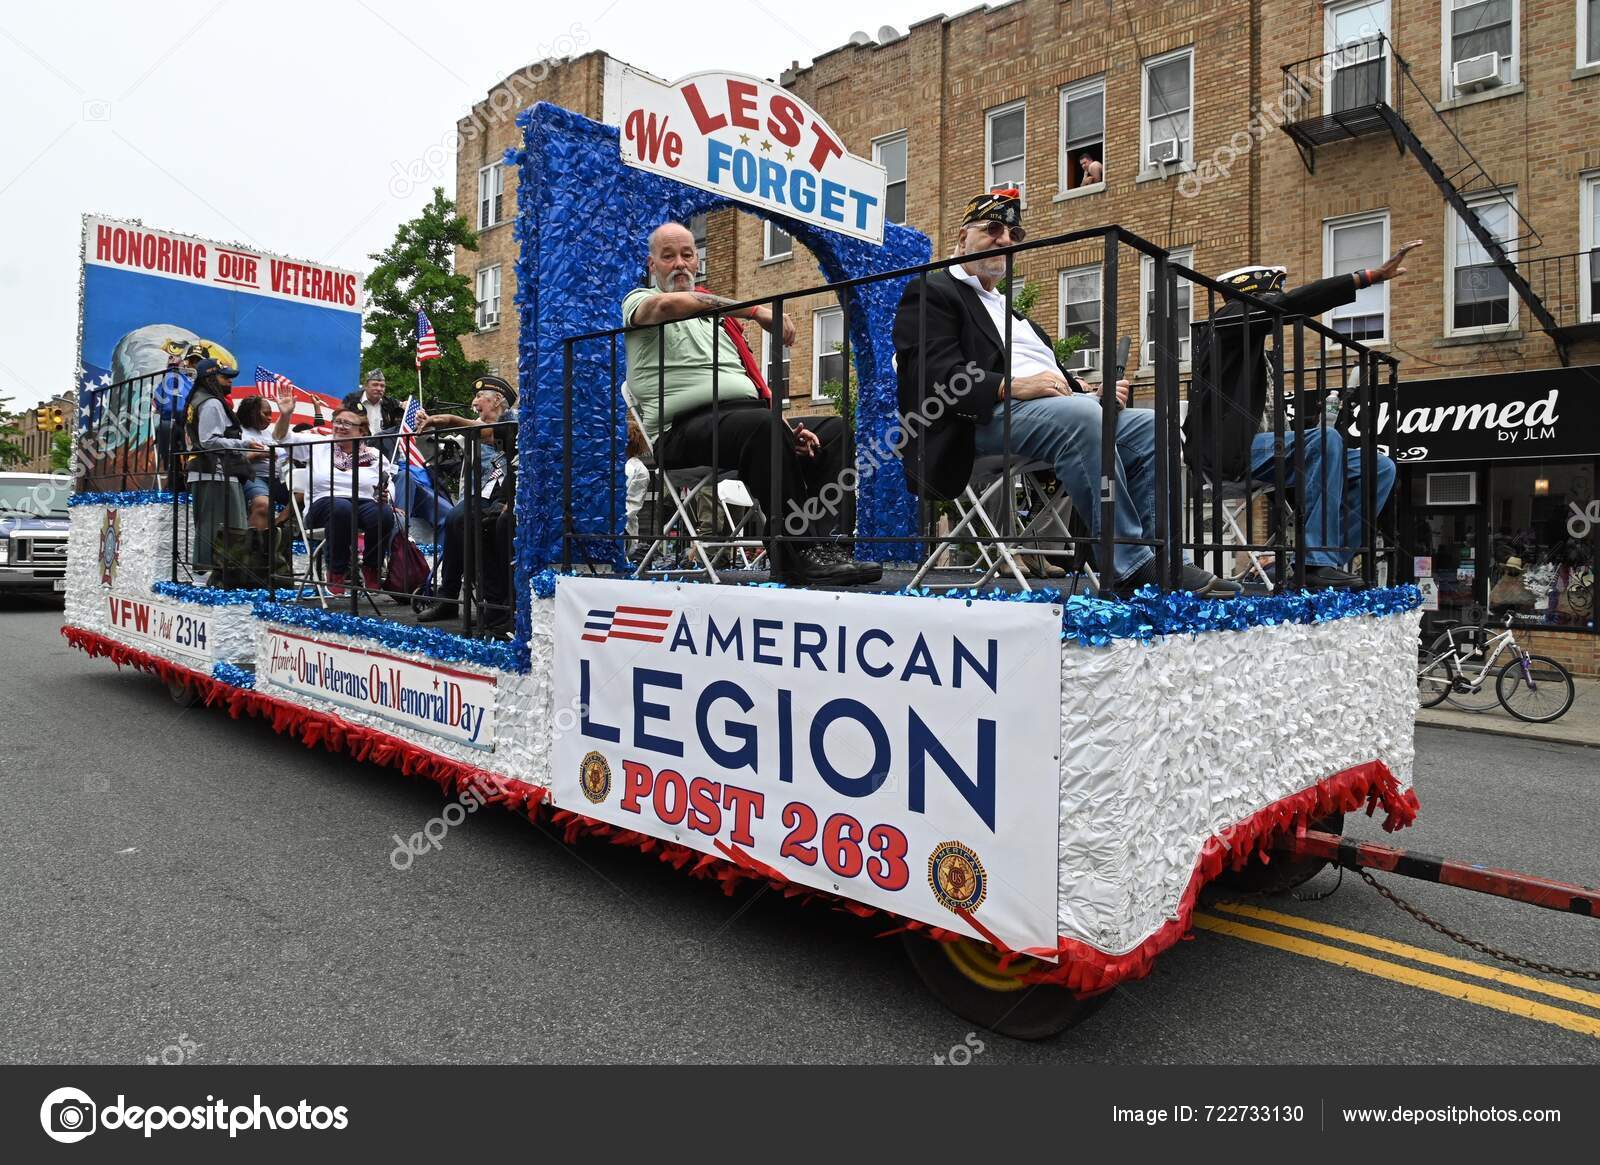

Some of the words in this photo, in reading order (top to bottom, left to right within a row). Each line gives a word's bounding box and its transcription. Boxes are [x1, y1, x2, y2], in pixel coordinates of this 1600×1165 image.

[681, 79, 843, 173] LEST
[625, 109, 683, 168] We
[708, 138, 878, 230] FORGET
[96, 224, 206, 279] HONORING
[218, 253, 257, 284] OUR
[270, 259, 356, 306] VETERANS
[1498, 429, 1519, 444] by
[1523, 427, 1555, 441] JLM
[109, 596, 150, 634] VFW
[159, 612, 174, 640] Post
[176, 615, 207, 650] 2314
[669, 611, 998, 695] AMERICAN
[580, 659, 997, 835] LEGION
[620, 759, 765, 849] POST
[780, 801, 910, 892] 263
[936, 848, 981, 876] AMERICAN
